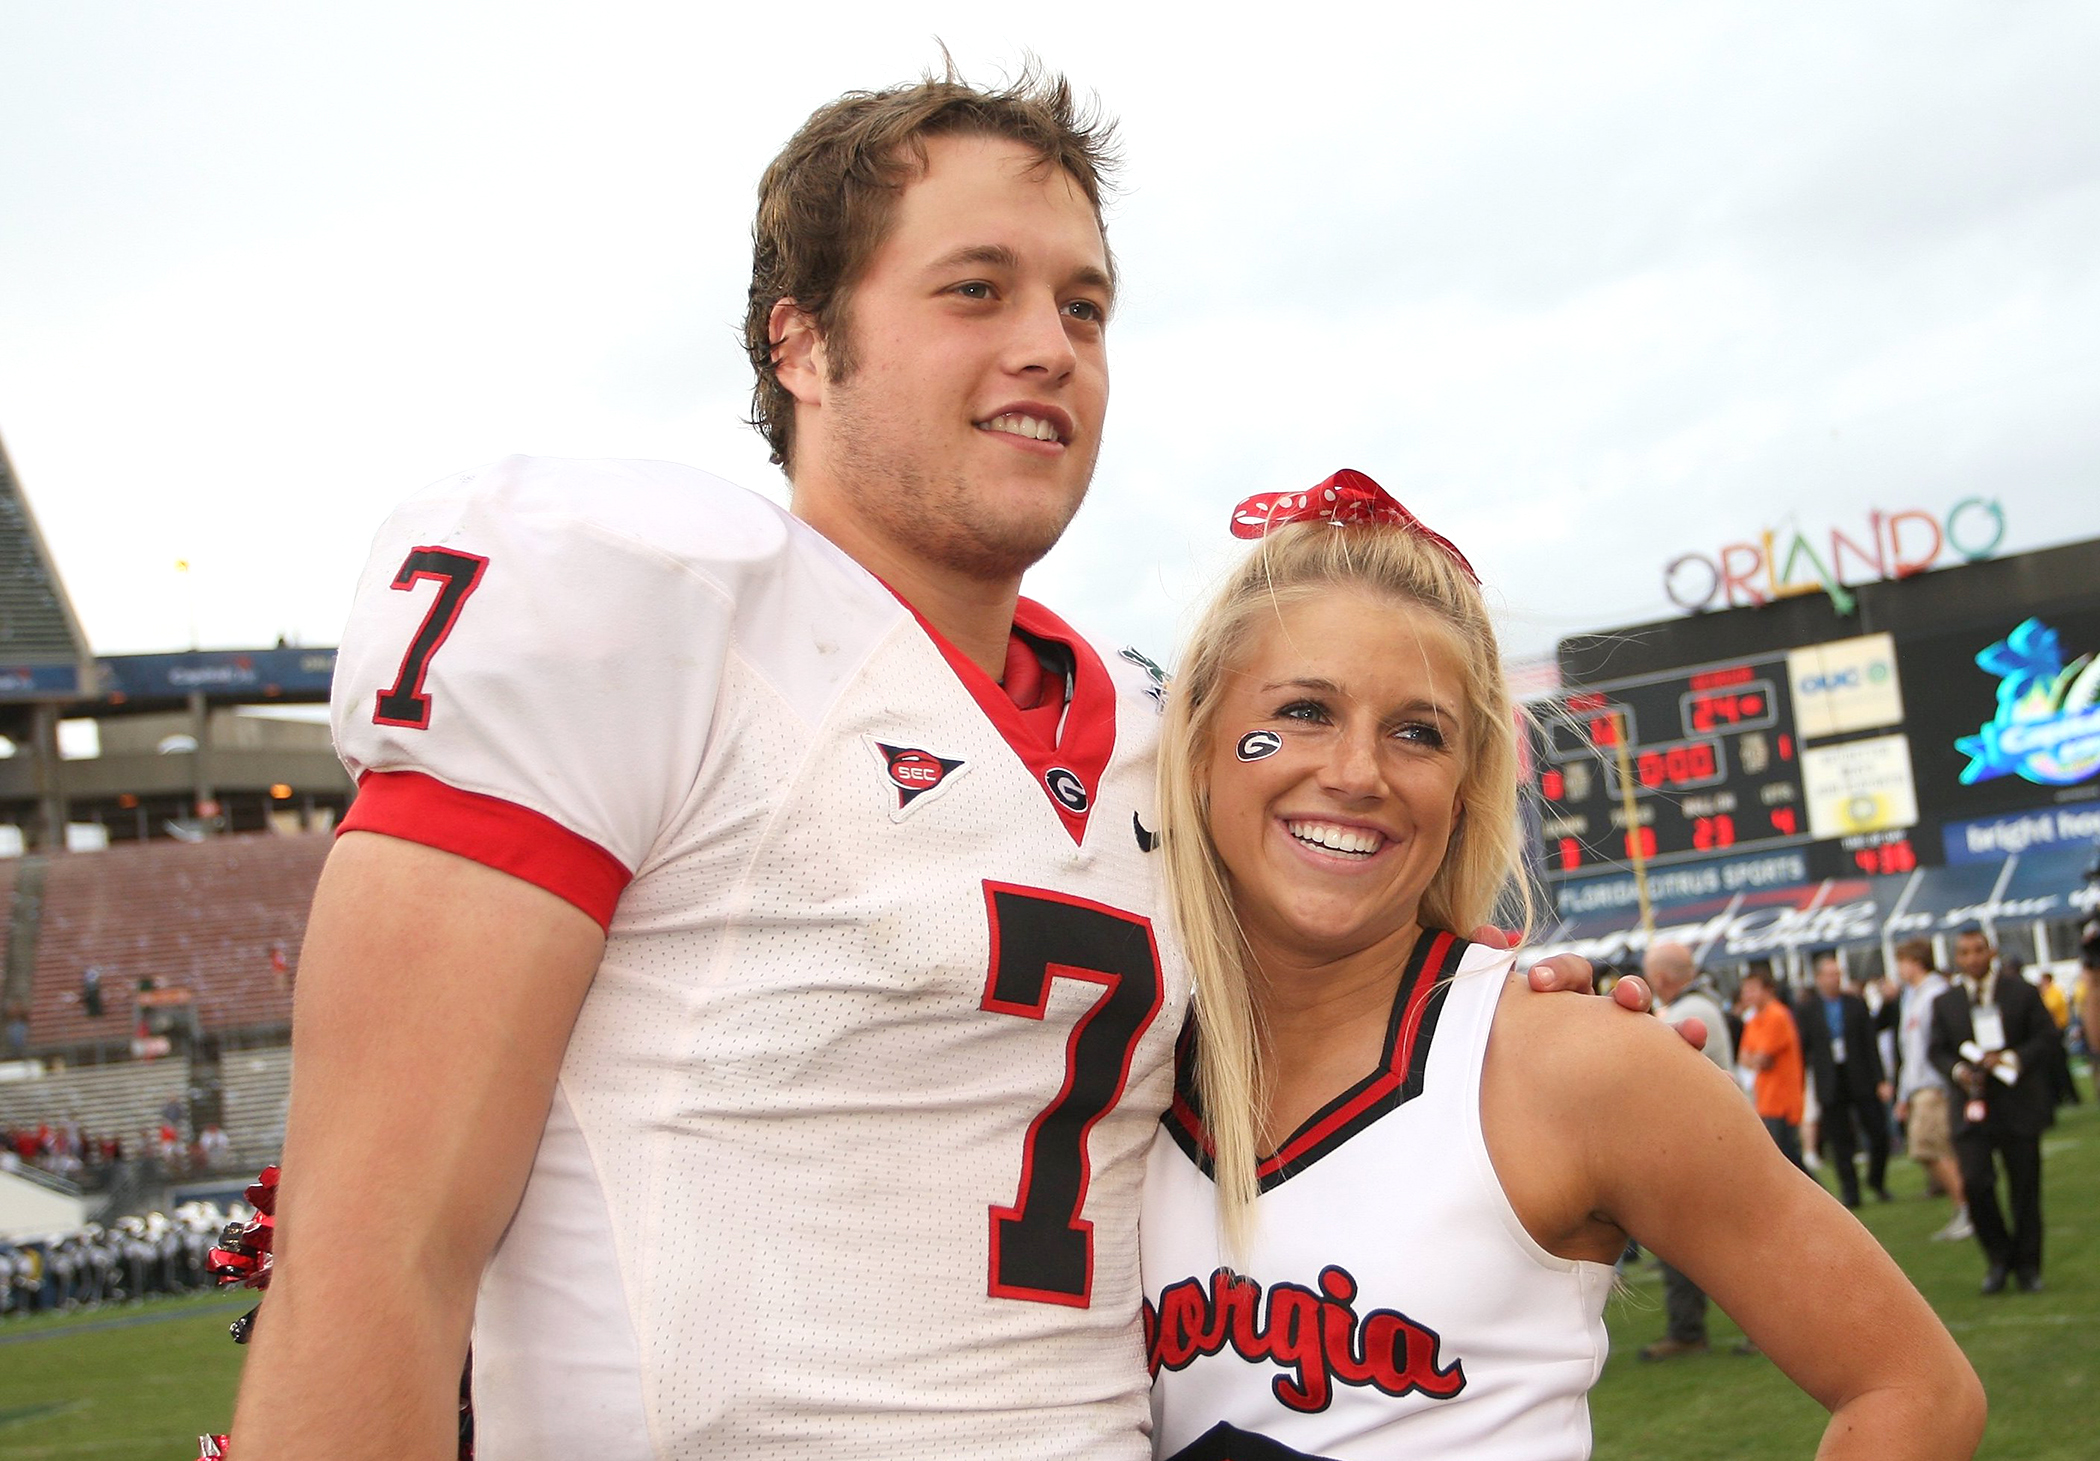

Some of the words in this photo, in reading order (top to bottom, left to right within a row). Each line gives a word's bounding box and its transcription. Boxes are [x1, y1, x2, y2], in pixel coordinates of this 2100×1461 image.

[1665, 497, 2006, 615] ORLANDO
[373, 546, 490, 730] 7
[897, 766, 937, 781] SEC
[1237, 730, 1282, 761] G
[1722, 854, 1806, 890] SPORTS
[980, 880, 1164, 1308] 7
